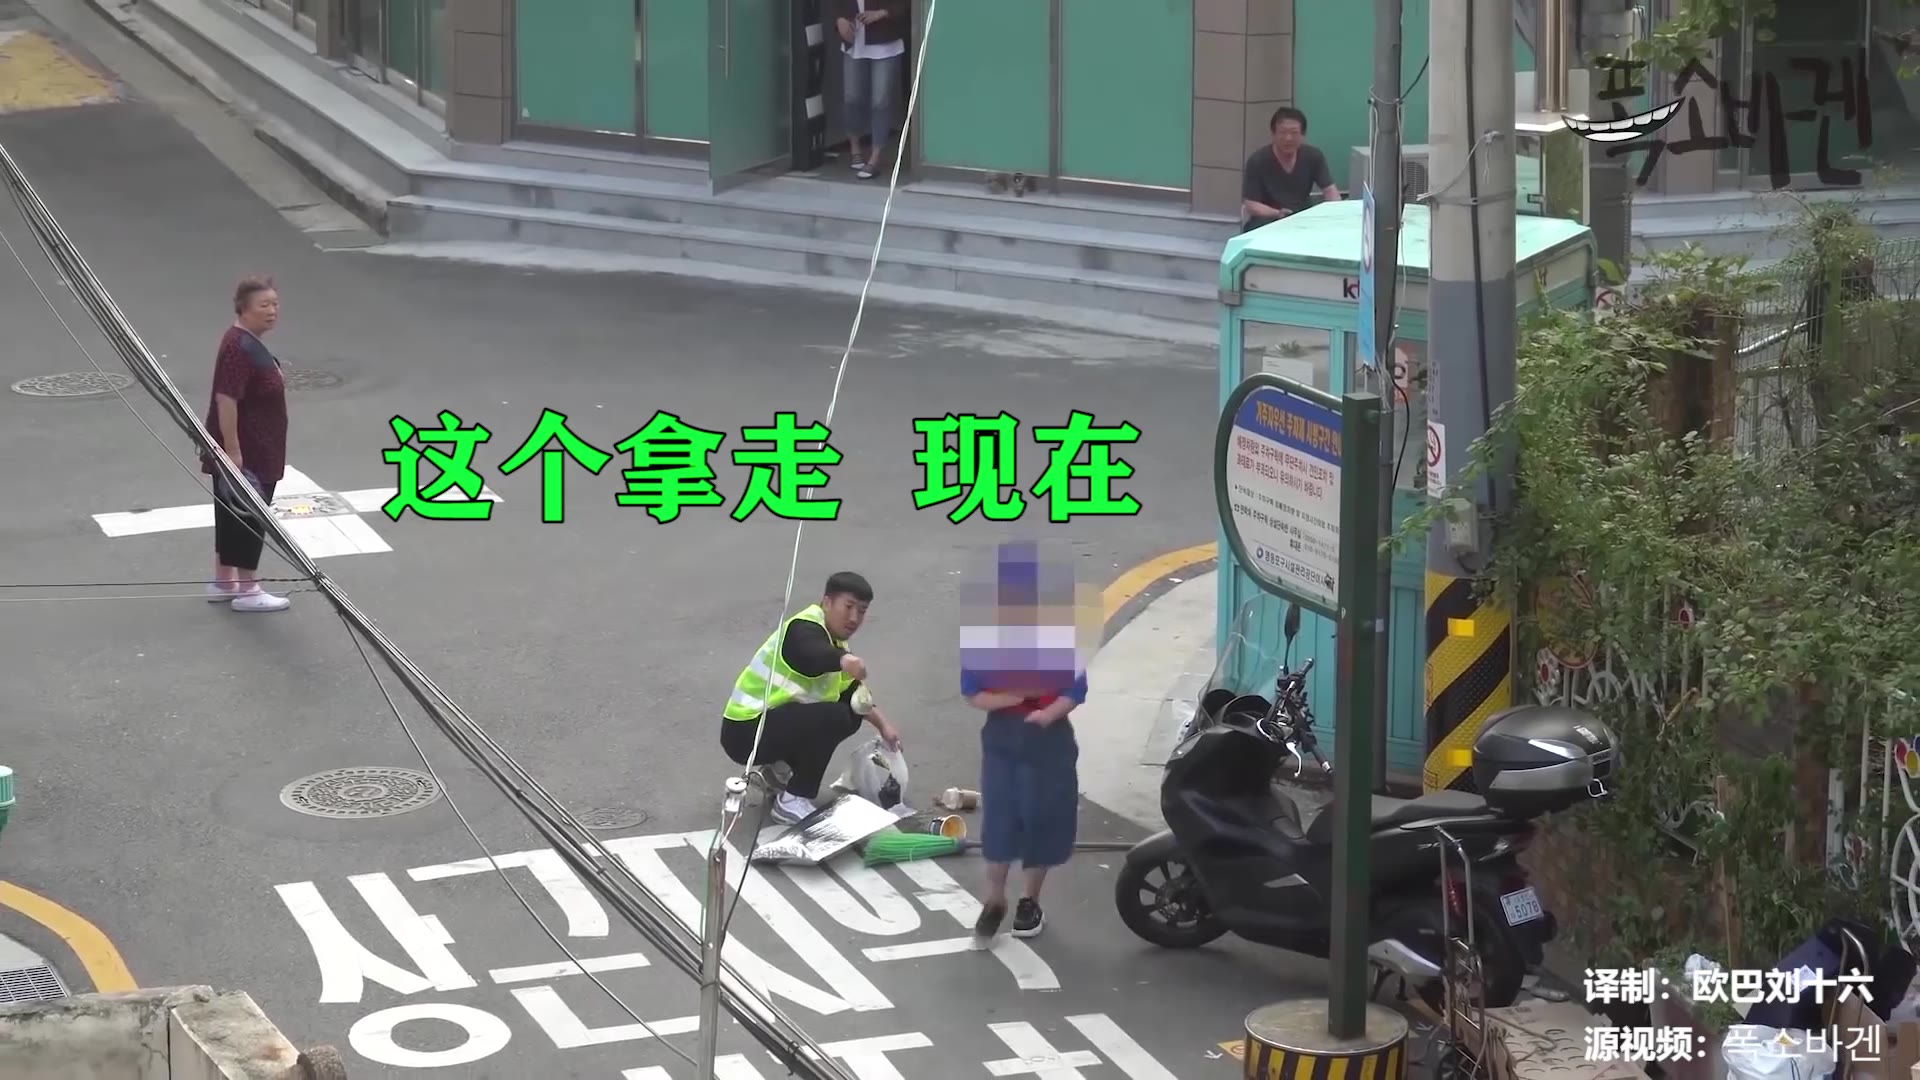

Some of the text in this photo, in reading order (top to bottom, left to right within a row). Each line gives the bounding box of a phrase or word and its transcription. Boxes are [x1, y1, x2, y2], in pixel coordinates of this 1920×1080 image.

[1237, 453, 1255, 474] 과태료가
[1255, 461, 1278, 482] 부과되오니
[1279, 469, 1303, 492] 유의하시기
[1265, 552, 1335, 592] 영등포구시설관리공단이사
[1515, 900, 1539, 918] 5078
